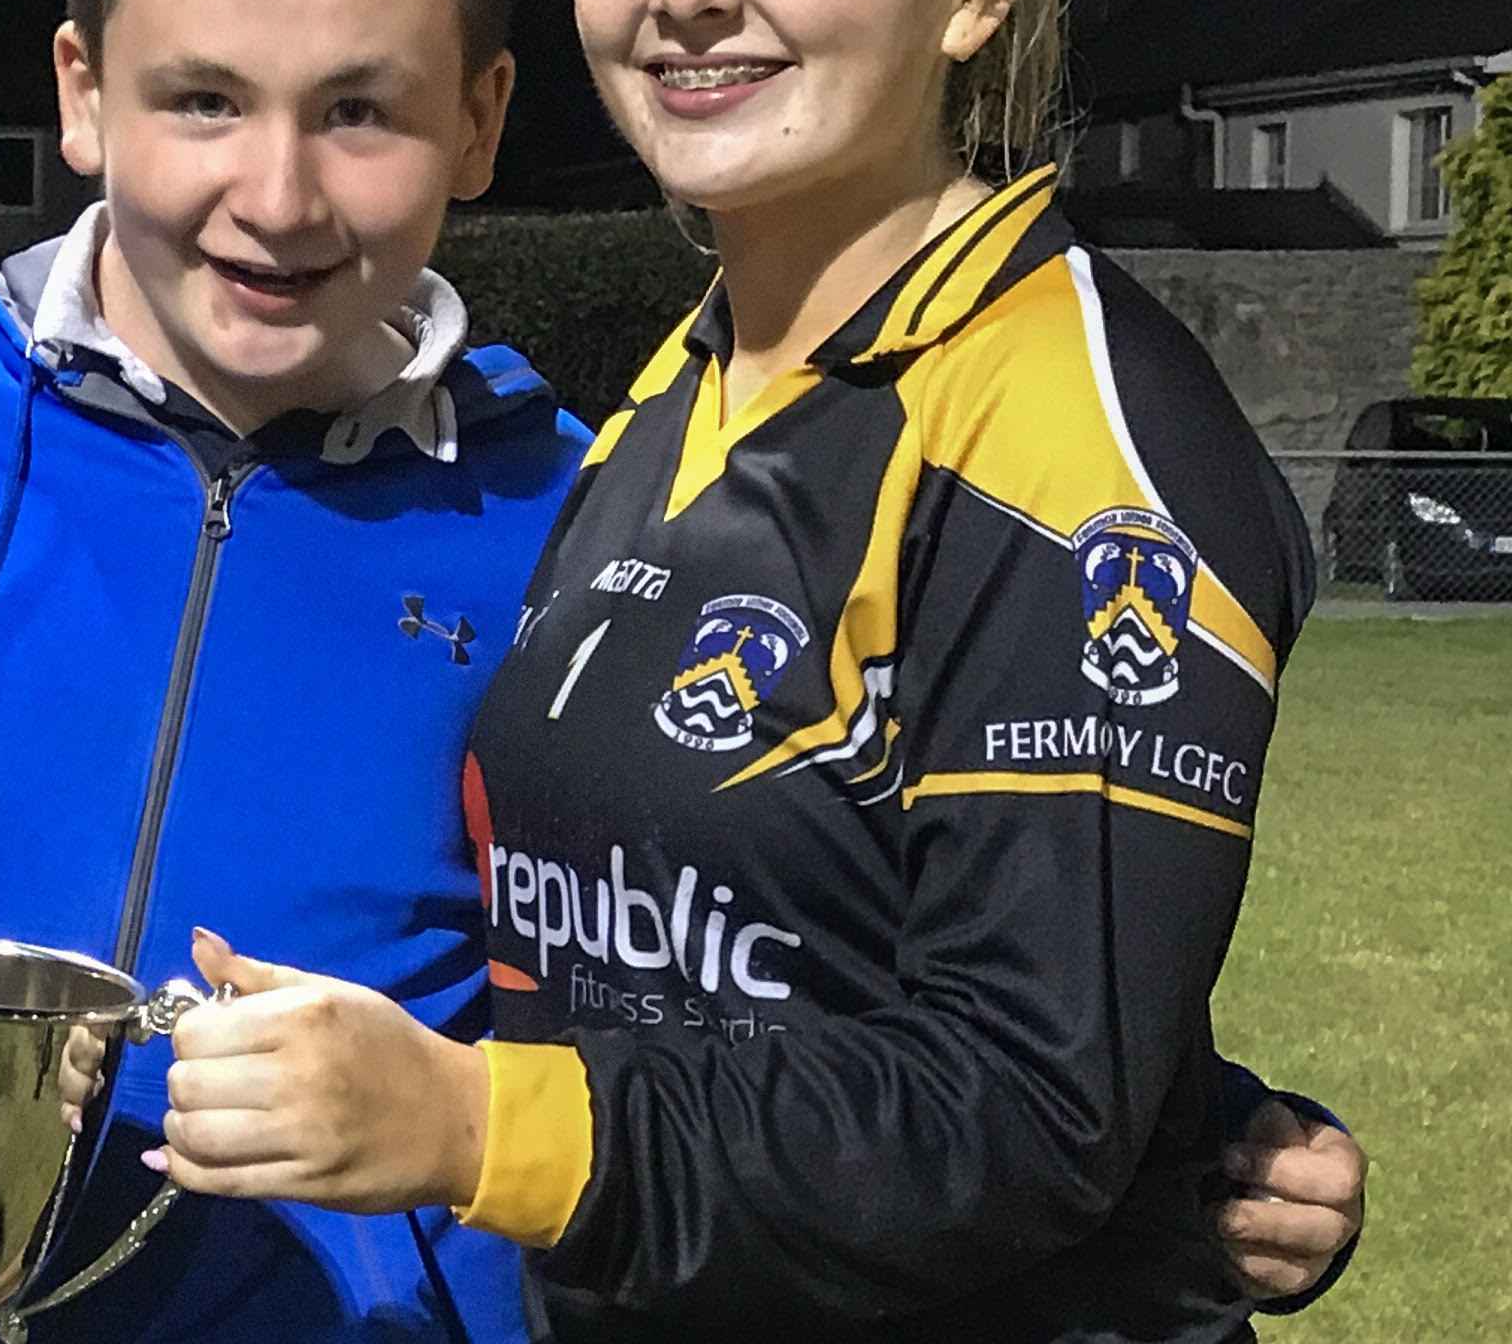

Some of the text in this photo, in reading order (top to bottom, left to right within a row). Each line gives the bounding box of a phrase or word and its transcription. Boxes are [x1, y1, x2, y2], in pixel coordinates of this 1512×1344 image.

[547, 618, 612, 720] 1
[985, 716, 1248, 806] FERMOY LGFC
[489, 844, 803, 1000] republic
[570, 963, 666, 1024] fitnss
